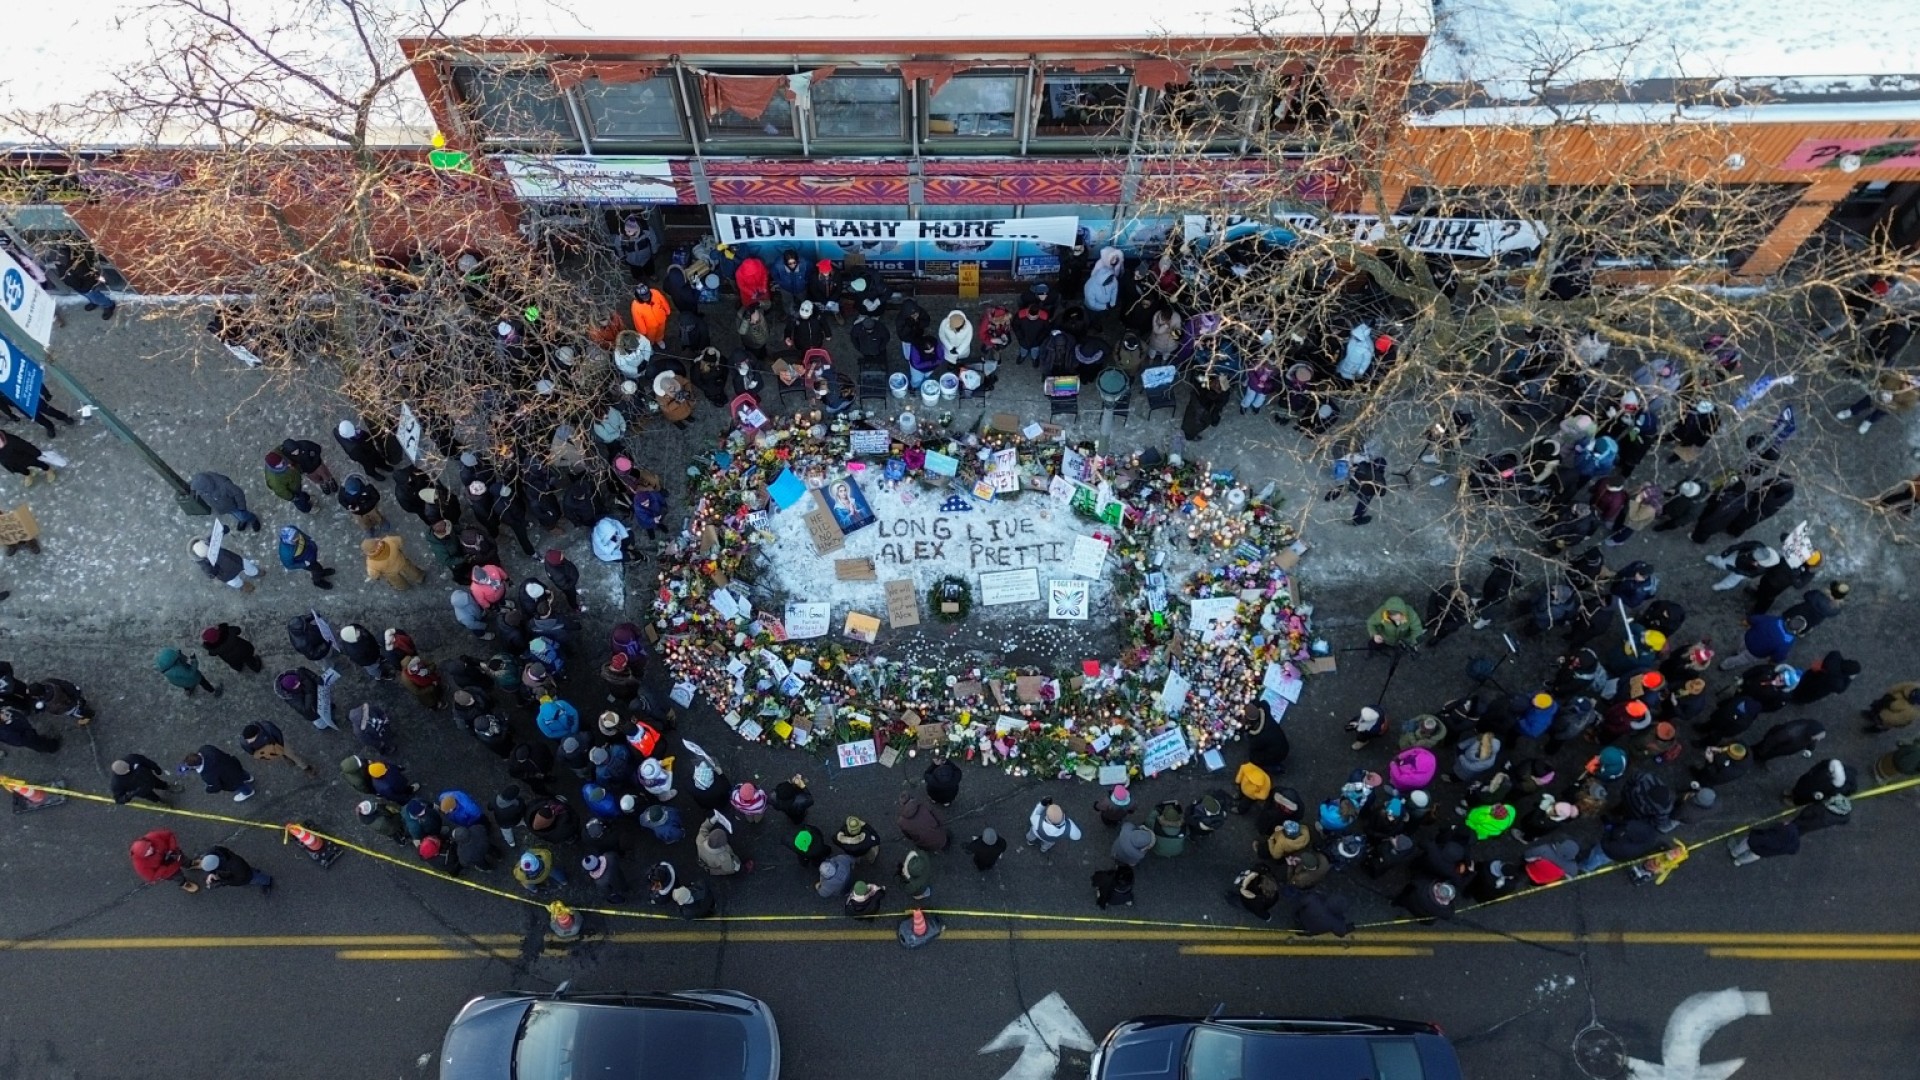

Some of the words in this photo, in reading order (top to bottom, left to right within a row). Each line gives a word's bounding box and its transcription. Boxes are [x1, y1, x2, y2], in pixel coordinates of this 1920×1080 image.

[731, 216, 796, 240] HOW
[815, 219, 902, 238] MANY
[17, 358, 26, 386] street
[810, 513, 823, 524] HE
[878, 517, 951, 540] LONG
[967, 518, 1035, 542] LIVE
[880, 541, 946, 564] ALEX
[969, 541, 1065, 569] PRETTI
